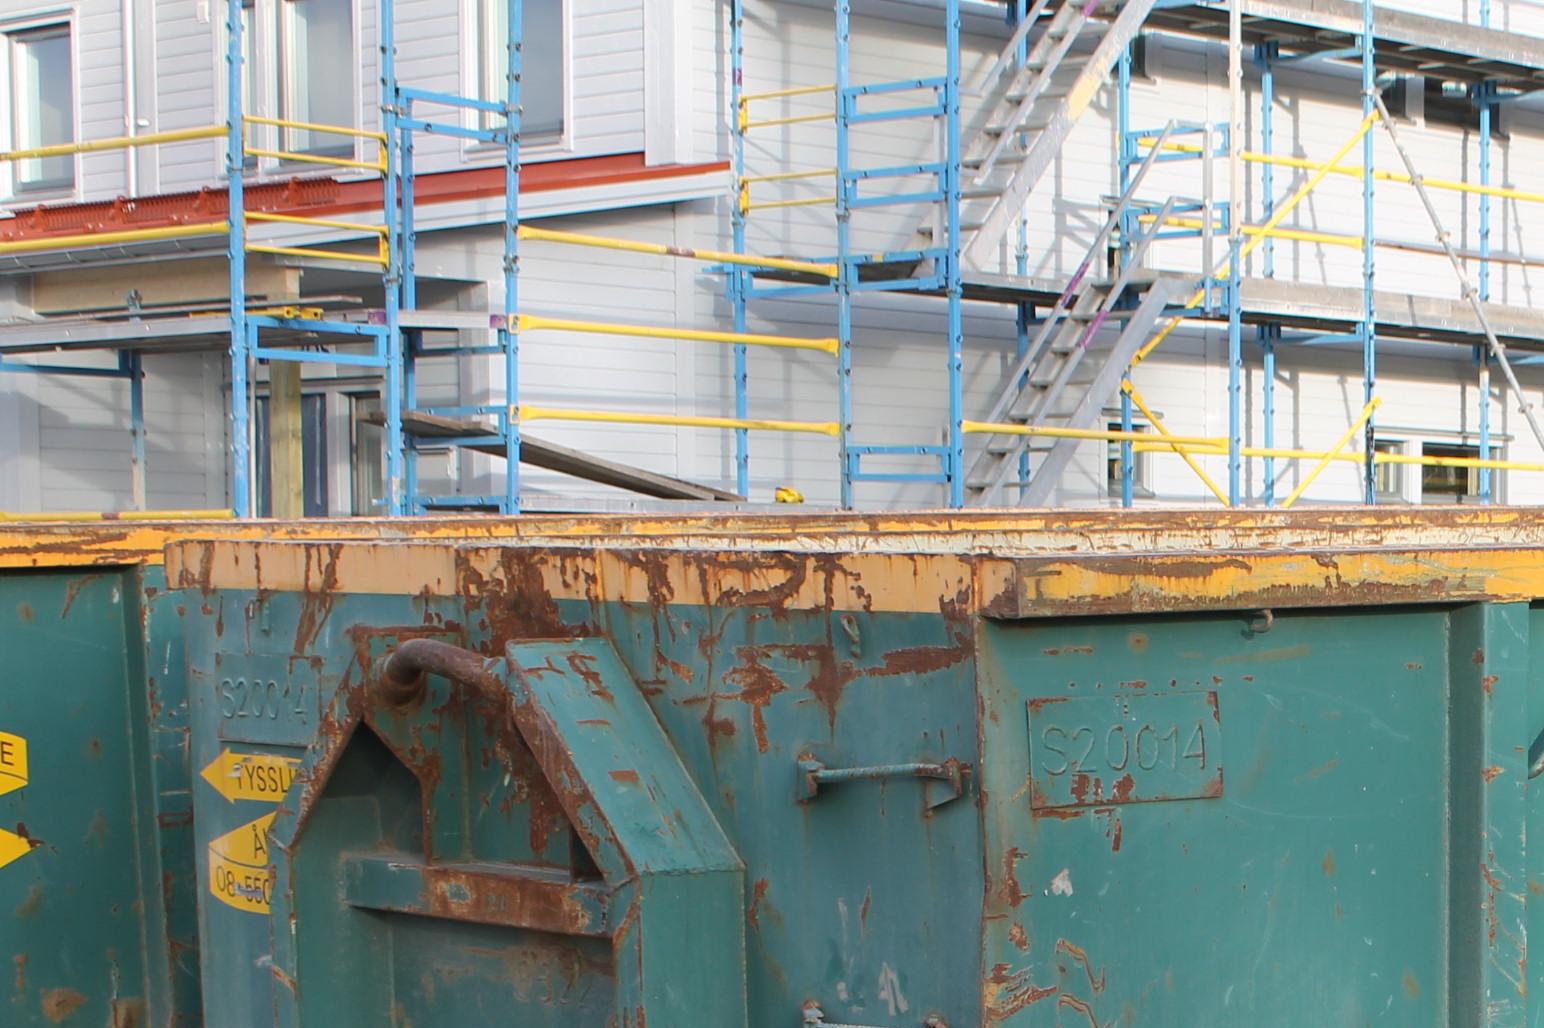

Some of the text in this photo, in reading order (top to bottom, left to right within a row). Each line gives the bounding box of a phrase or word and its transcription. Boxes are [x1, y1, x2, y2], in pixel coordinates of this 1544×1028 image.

[1041, 722, 1206, 776] S20014
[238, 763, 297, 793] YSSLI
[216, 865, 271, 906] 08550
